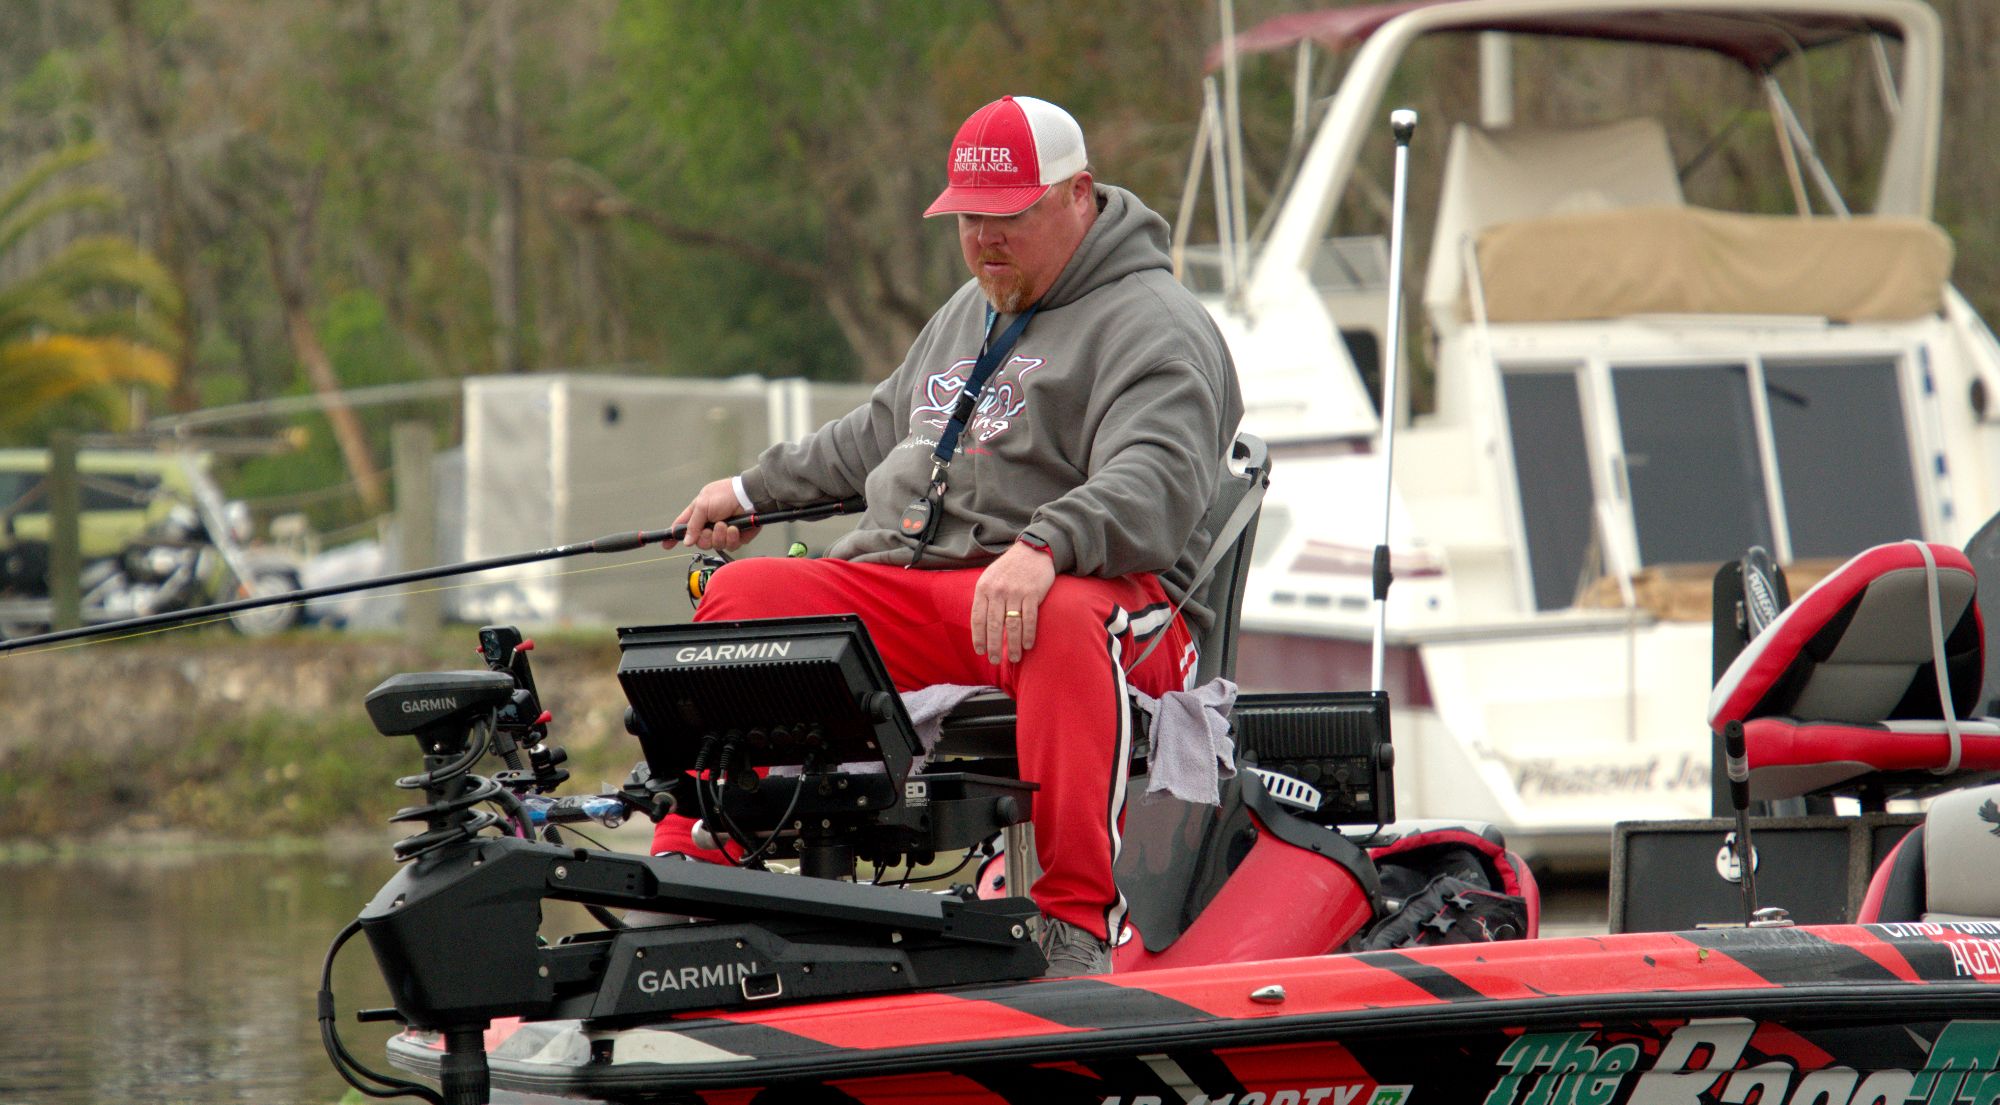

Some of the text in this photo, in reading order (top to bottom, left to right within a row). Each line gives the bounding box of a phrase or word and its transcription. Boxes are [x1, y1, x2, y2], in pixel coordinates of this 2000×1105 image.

[954, 146, 1012, 163] SHELTER
[675, 641, 791, 662] GARMIN
[401, 697, 457, 713] GARMIN
[637, 961, 757, 993] GARMIN
